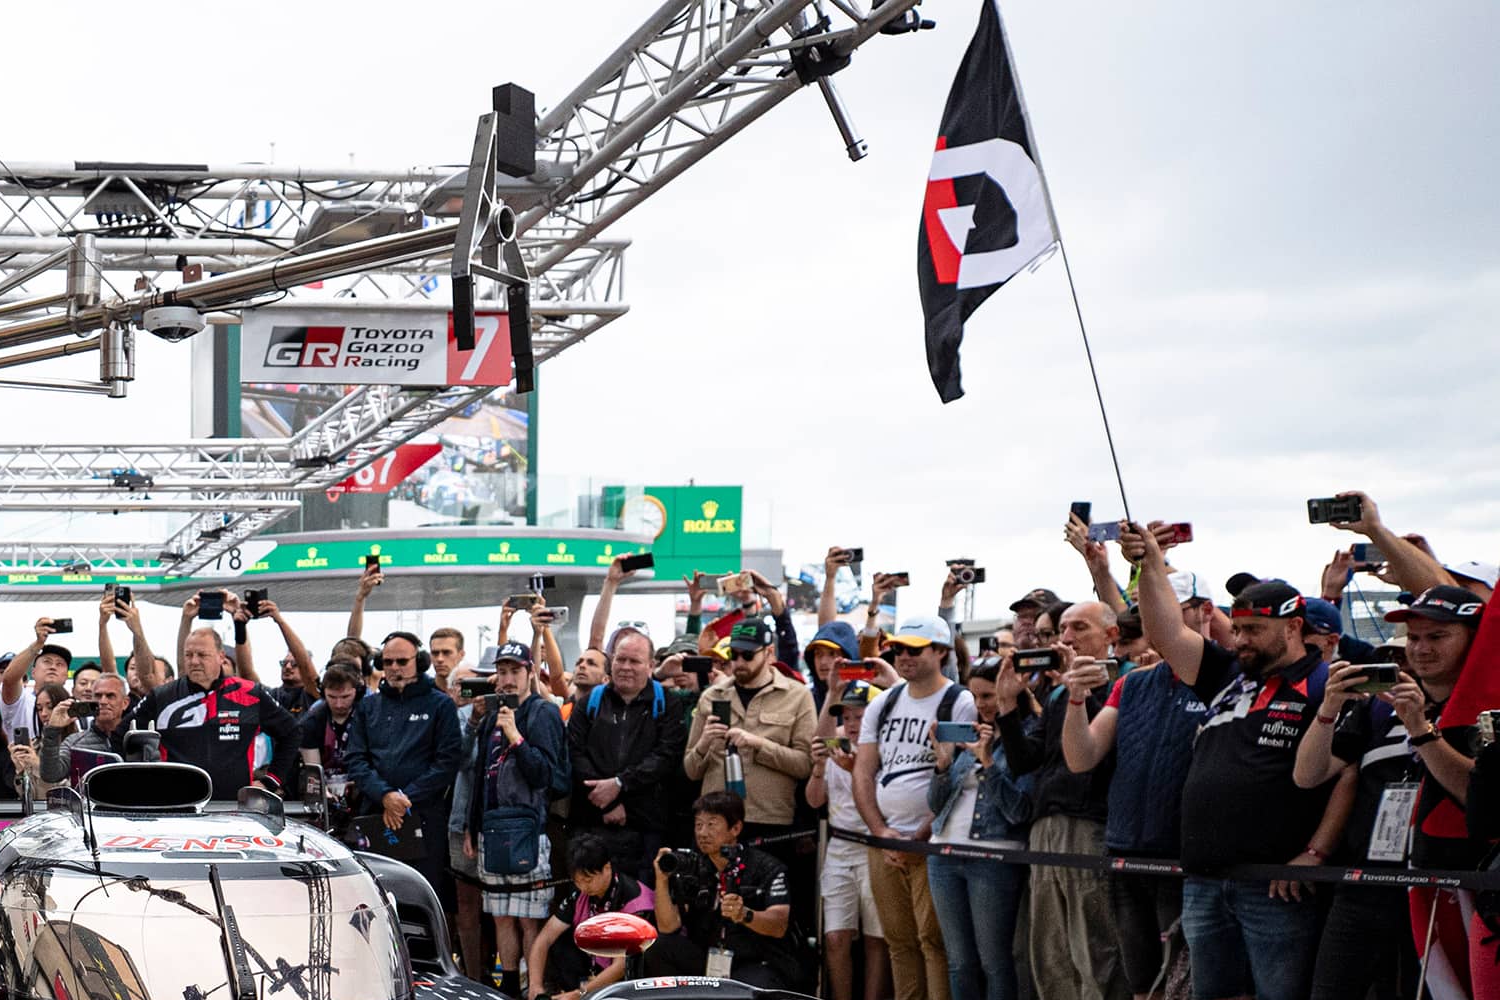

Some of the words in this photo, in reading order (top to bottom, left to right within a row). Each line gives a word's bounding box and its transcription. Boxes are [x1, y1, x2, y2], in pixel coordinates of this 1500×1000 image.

[350, 327, 433, 340] TOYOTA
[347, 341, 425, 354] GAZOO
[460, 316, 500, 381] 7
[267, 342, 339, 367] GR
[344, 355, 421, 371] Racing
[684, 520, 736, 533] ROLEX
[296, 558, 328, 568] ROLEX
[424, 554, 458, 563] ROLEX
[488, 553, 520, 563] ROLEX
[547, 553, 575, 563] ROLEX
[1261, 720, 1299, 737] FUJITSU
[1257, 736, 1285, 748] Mobil
[103, 835, 285, 851] DENSO
